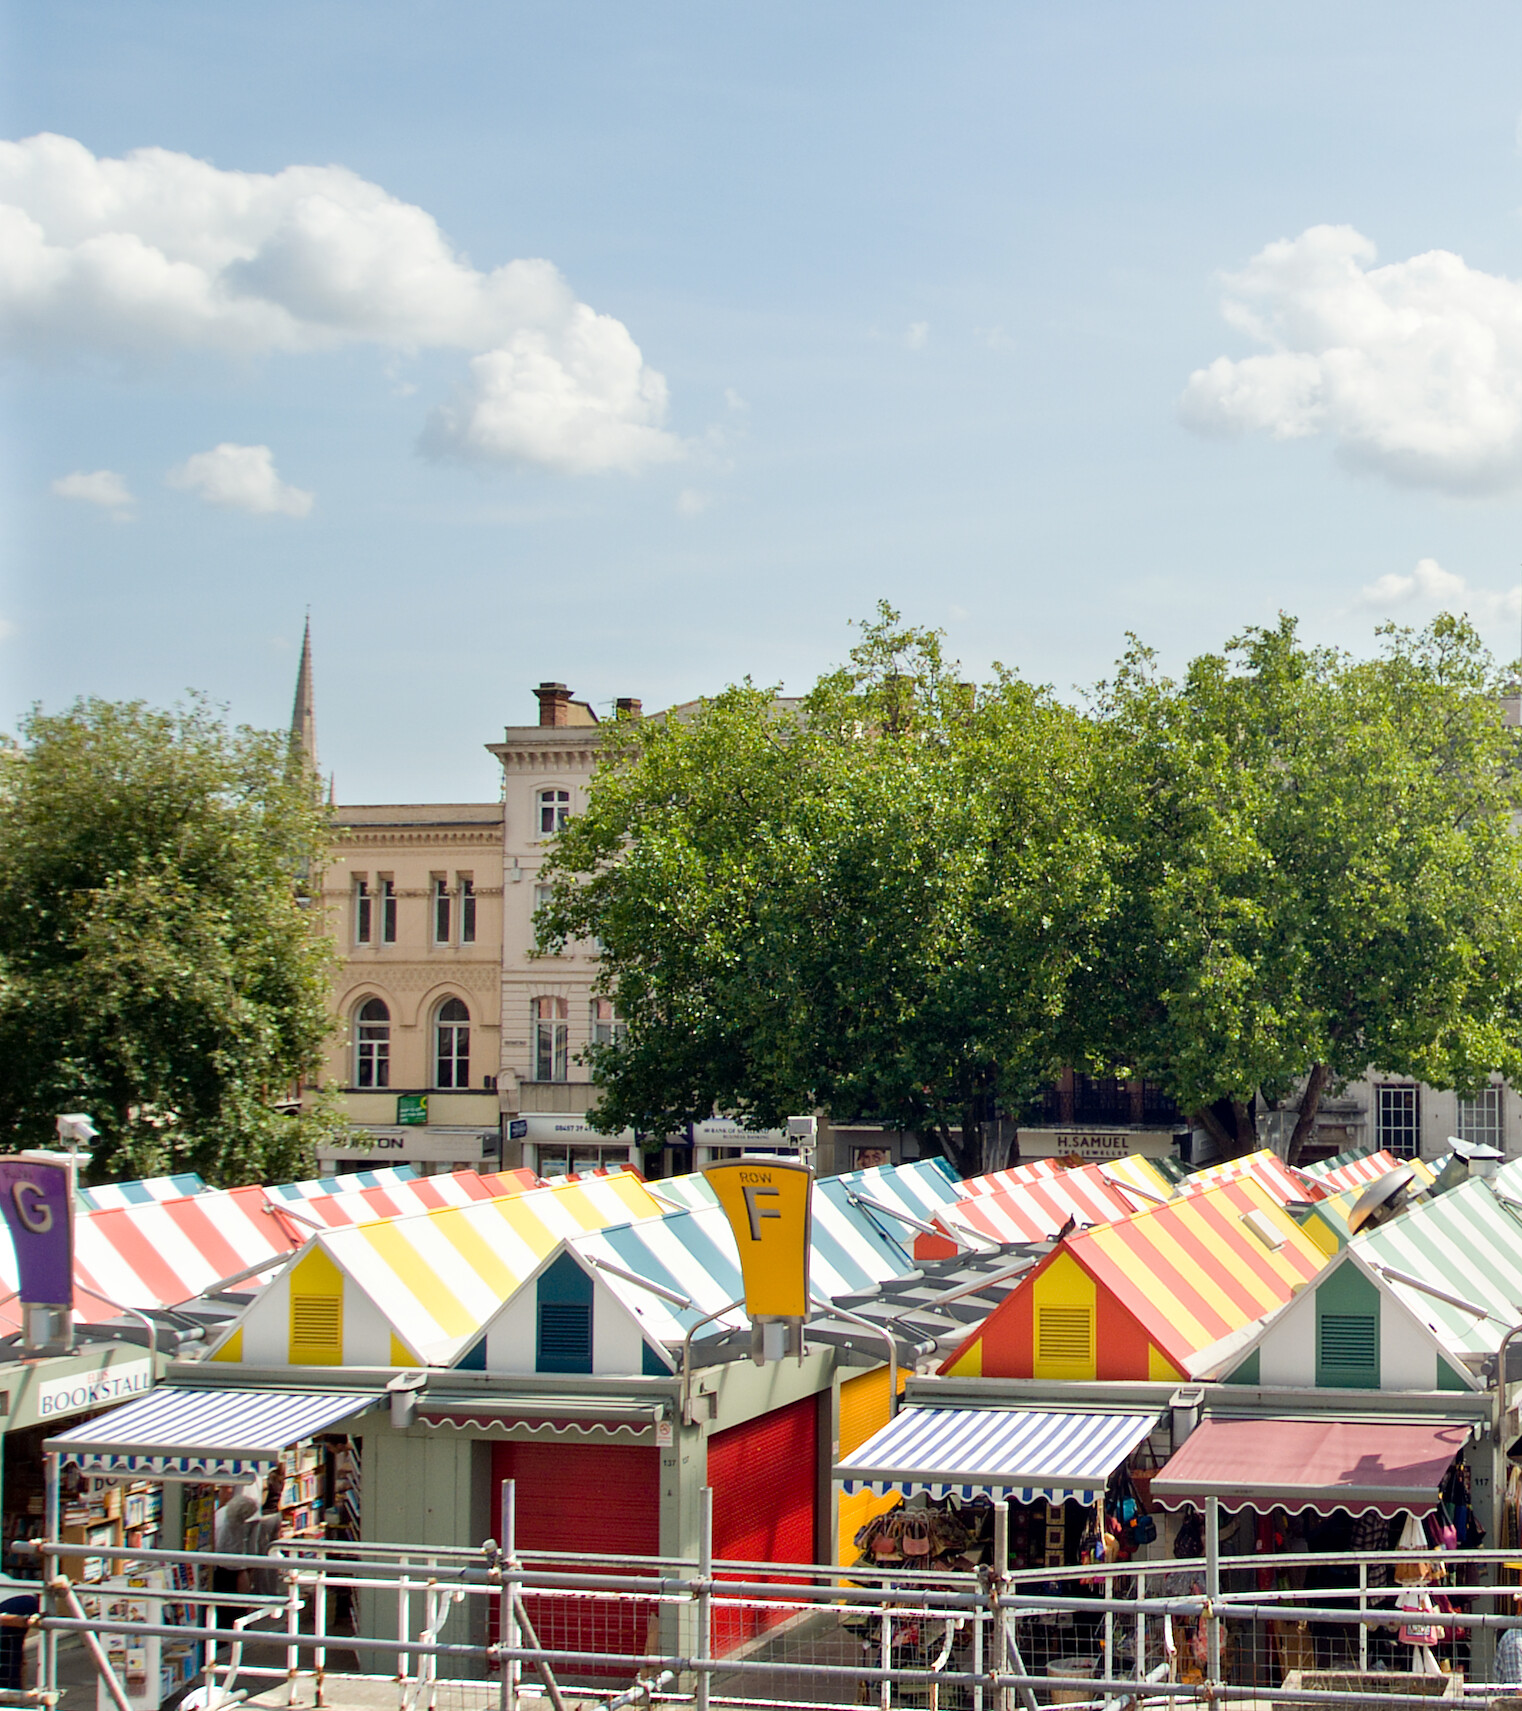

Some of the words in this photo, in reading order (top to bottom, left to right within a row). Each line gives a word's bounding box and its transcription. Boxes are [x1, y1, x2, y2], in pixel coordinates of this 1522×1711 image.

[1057, 1136, 1129, 1148] H.SAMUEL
[739, 1172, 772, 1183] ROW
[11, 1181, 53, 1234] G
[741, 1186, 781, 1241] F
[42, 1372, 150, 1414] BOOKSTALL
[1474, 1478, 1489, 1486] 117
